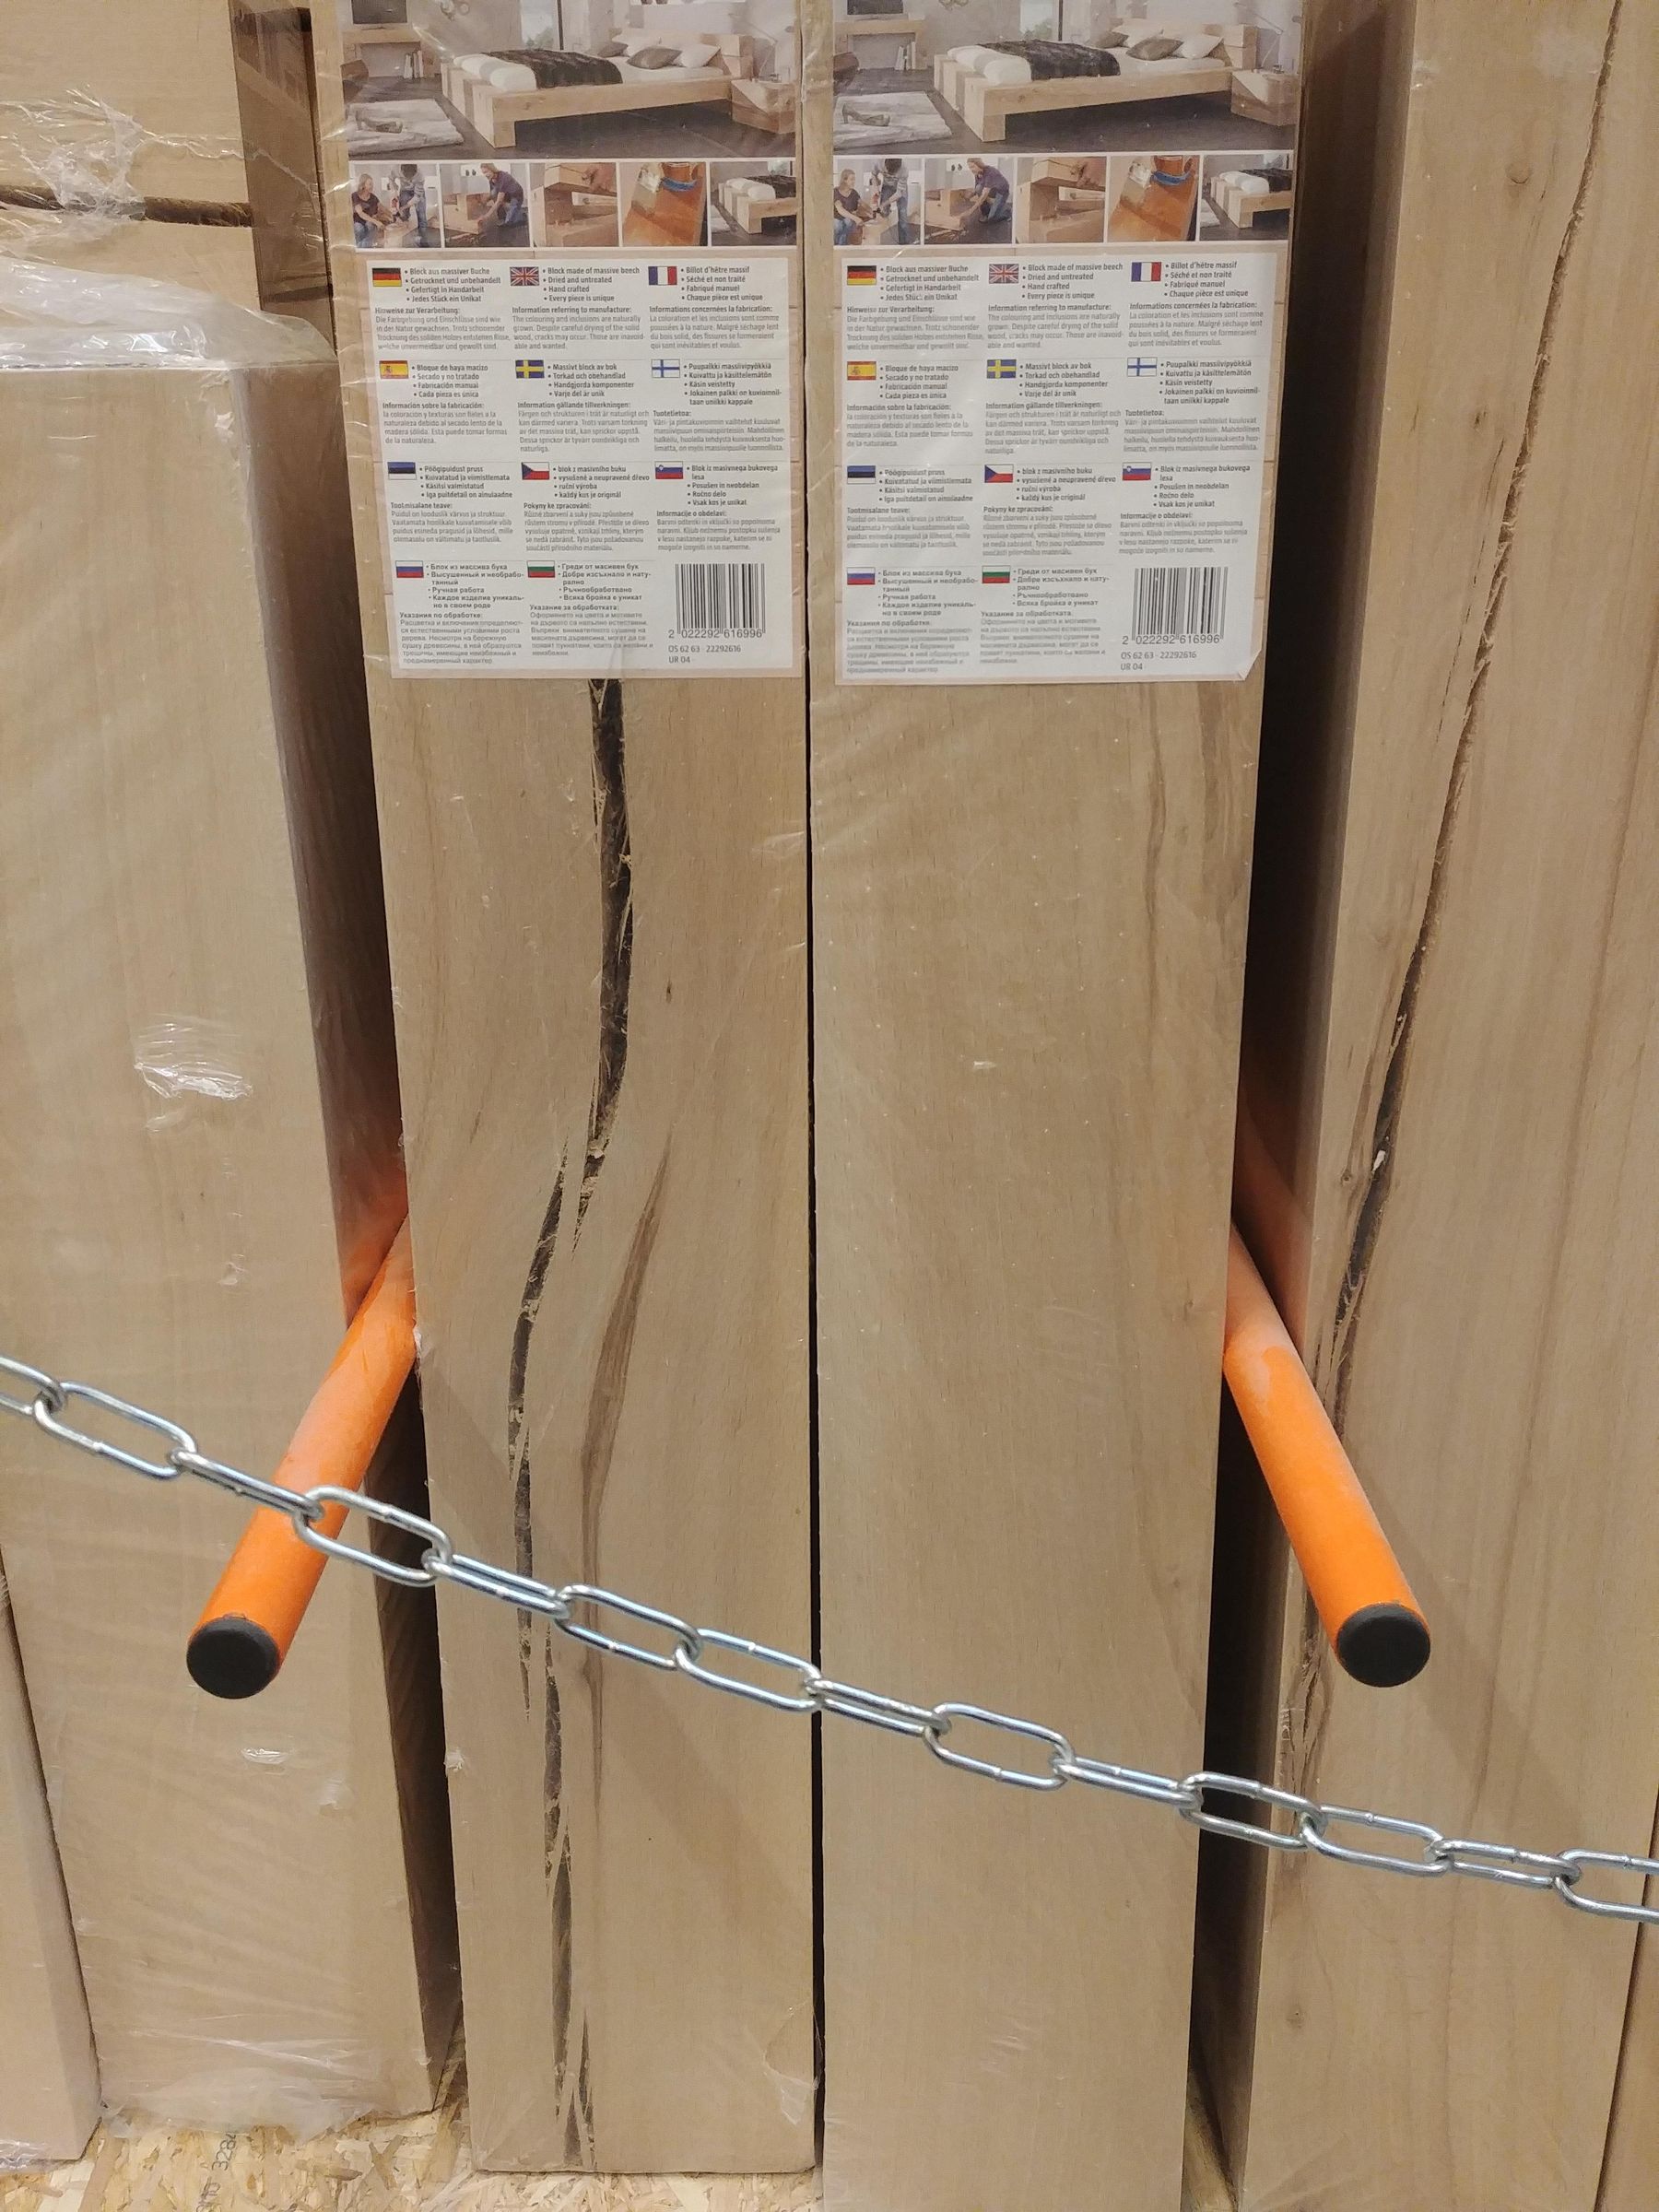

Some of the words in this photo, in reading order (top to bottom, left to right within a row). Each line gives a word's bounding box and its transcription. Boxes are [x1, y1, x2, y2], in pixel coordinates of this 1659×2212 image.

[686, 285, 714, 293] Fabriqué
[1170, 281, 1198, 289] Fabriqué
[411, 286, 440, 294] Gefertigt
[1169, 290, 1194, 299] Chaque
[1226, 289, 1249, 298] unique
[548, 294, 567, 302] Every
[568, 294, 584, 302] piece
[593, 294, 615, 302] unique
[686, 294, 711, 302] Chaque
[712, 294, 728, 302] pièce
[741, 294, 763, 302] unique
[1028, 292, 1045, 300] Every
[1047, 292, 1064, 300] piece
[417, 306, 461, 314] Verarbeitung:
[551, 306, 580, 314] referring
[525, 315, 555, 324] colouring
[613, 314, 641, 323] naturally
[417, 364, 439, 372] Bloque
[450, 364, 465, 372] haya
[708, 381, 735, 389] veistetty
[436, 391, 452, 399] pieza
[553, 390, 571, 398] Varje
[668, 629, 675, 639] 2
[681, 629, 720, 639] 022292
[724, 629, 762, 638] 616996
[1122, 636, 1129, 644] 2
[1135, 635, 1175, 644] 022292
[1180, 634, 1219, 643] 616996
